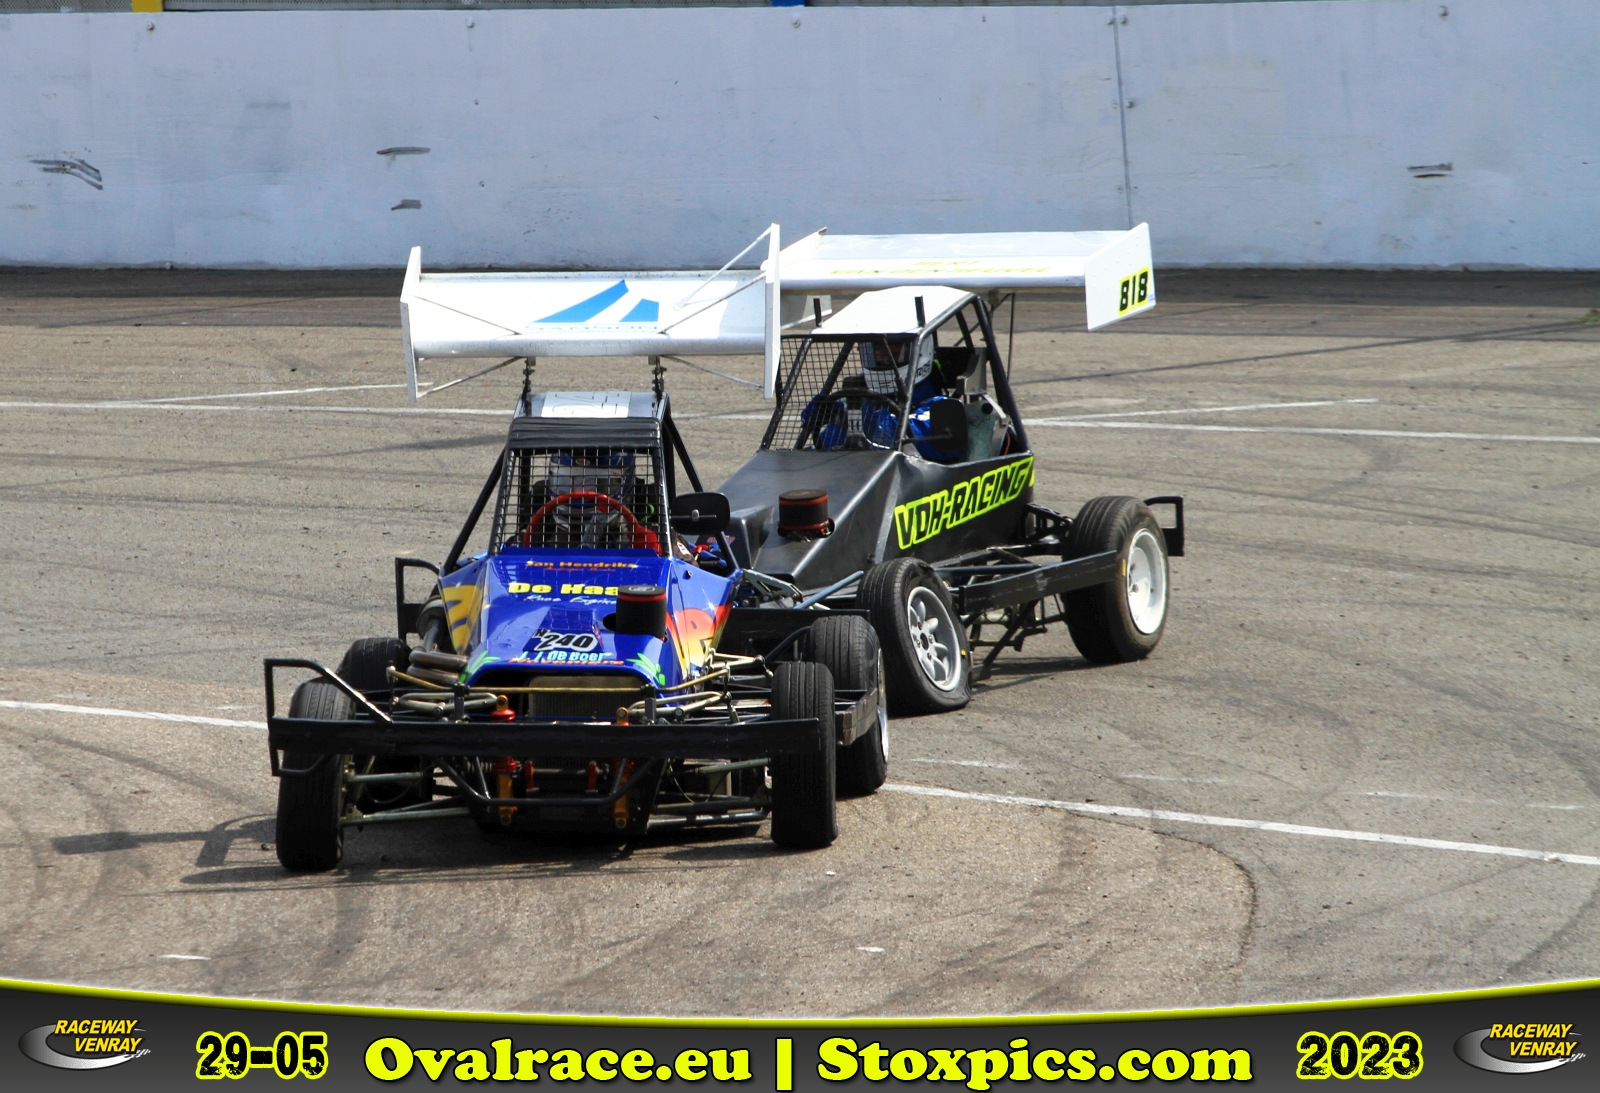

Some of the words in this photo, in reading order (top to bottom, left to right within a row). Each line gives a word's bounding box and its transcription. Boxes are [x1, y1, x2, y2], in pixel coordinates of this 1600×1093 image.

[1118, 270, 1149, 312] 818
[894, 456, 1034, 550] VDH-RACING
[508, 582, 552, 594] De
[561, 584, 619, 596] Haa
